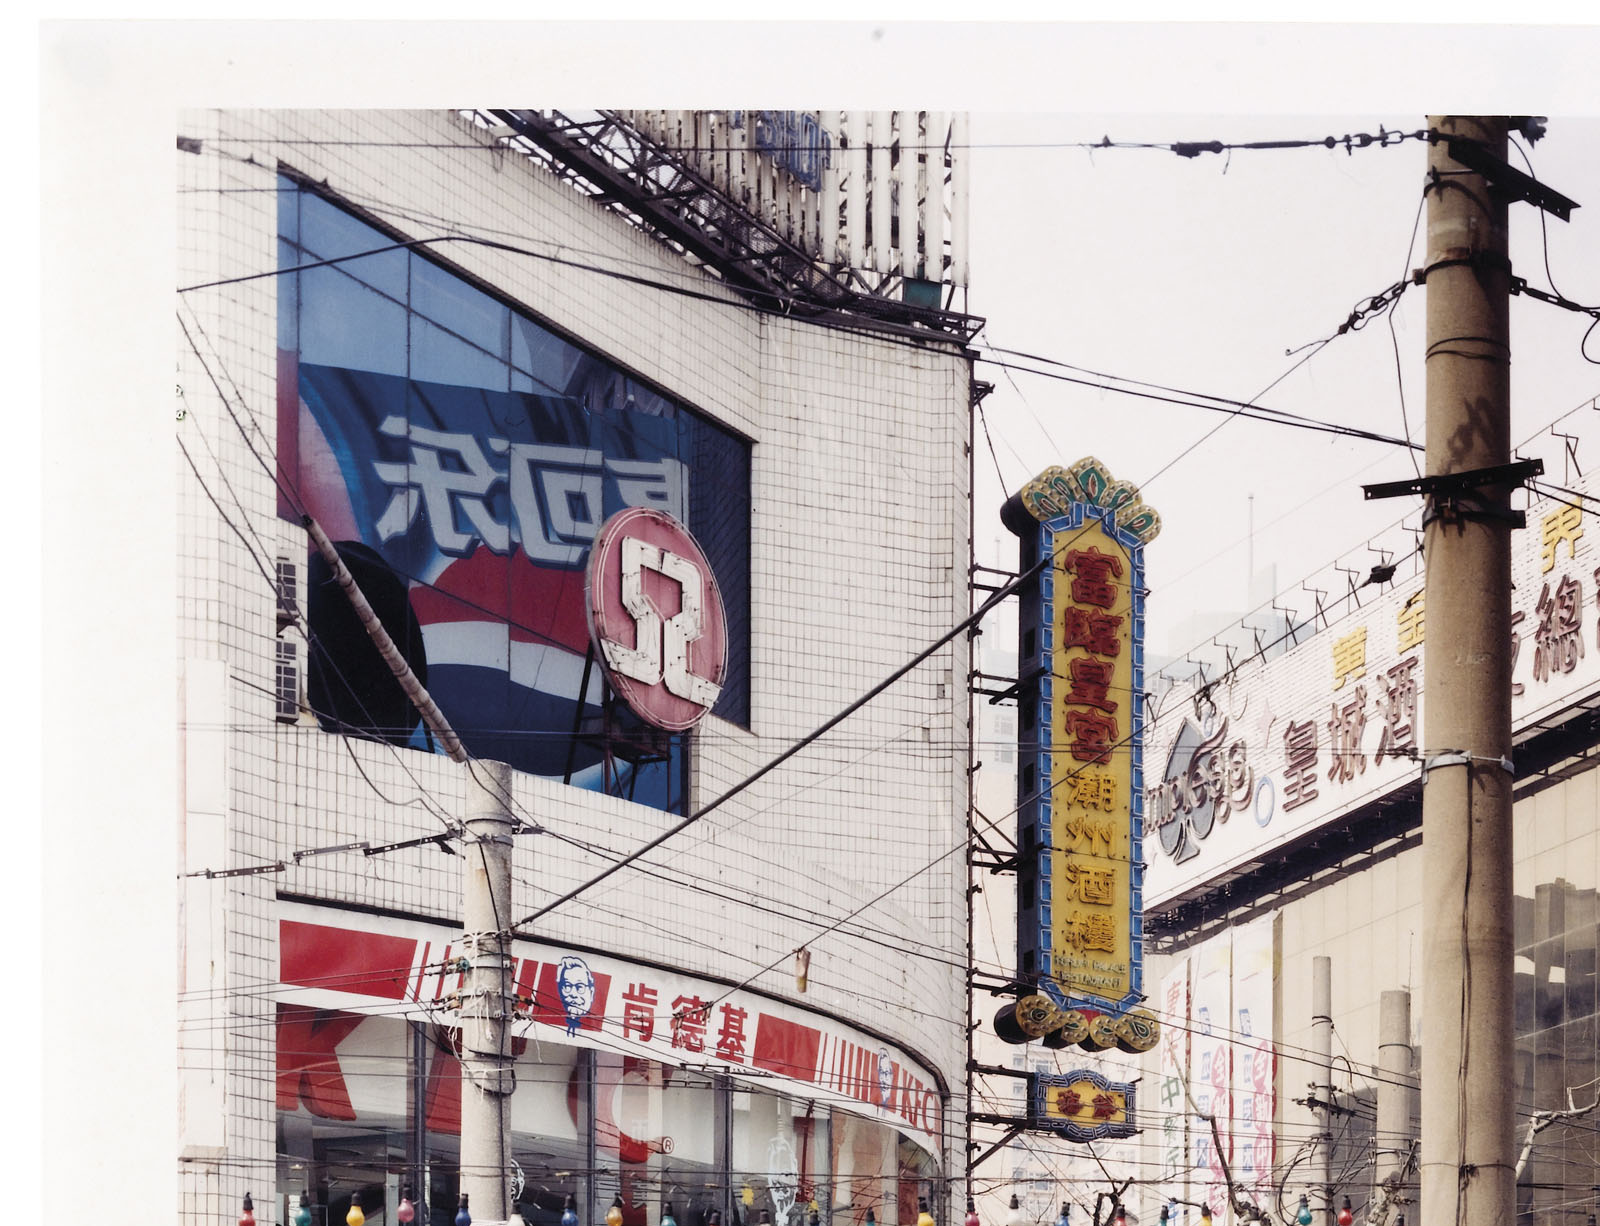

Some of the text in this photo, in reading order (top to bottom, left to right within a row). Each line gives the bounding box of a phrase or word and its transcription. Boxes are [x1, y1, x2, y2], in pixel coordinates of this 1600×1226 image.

[621, 981, 749, 1065] 肯德基
[900, 1068, 934, 1137] KFC
